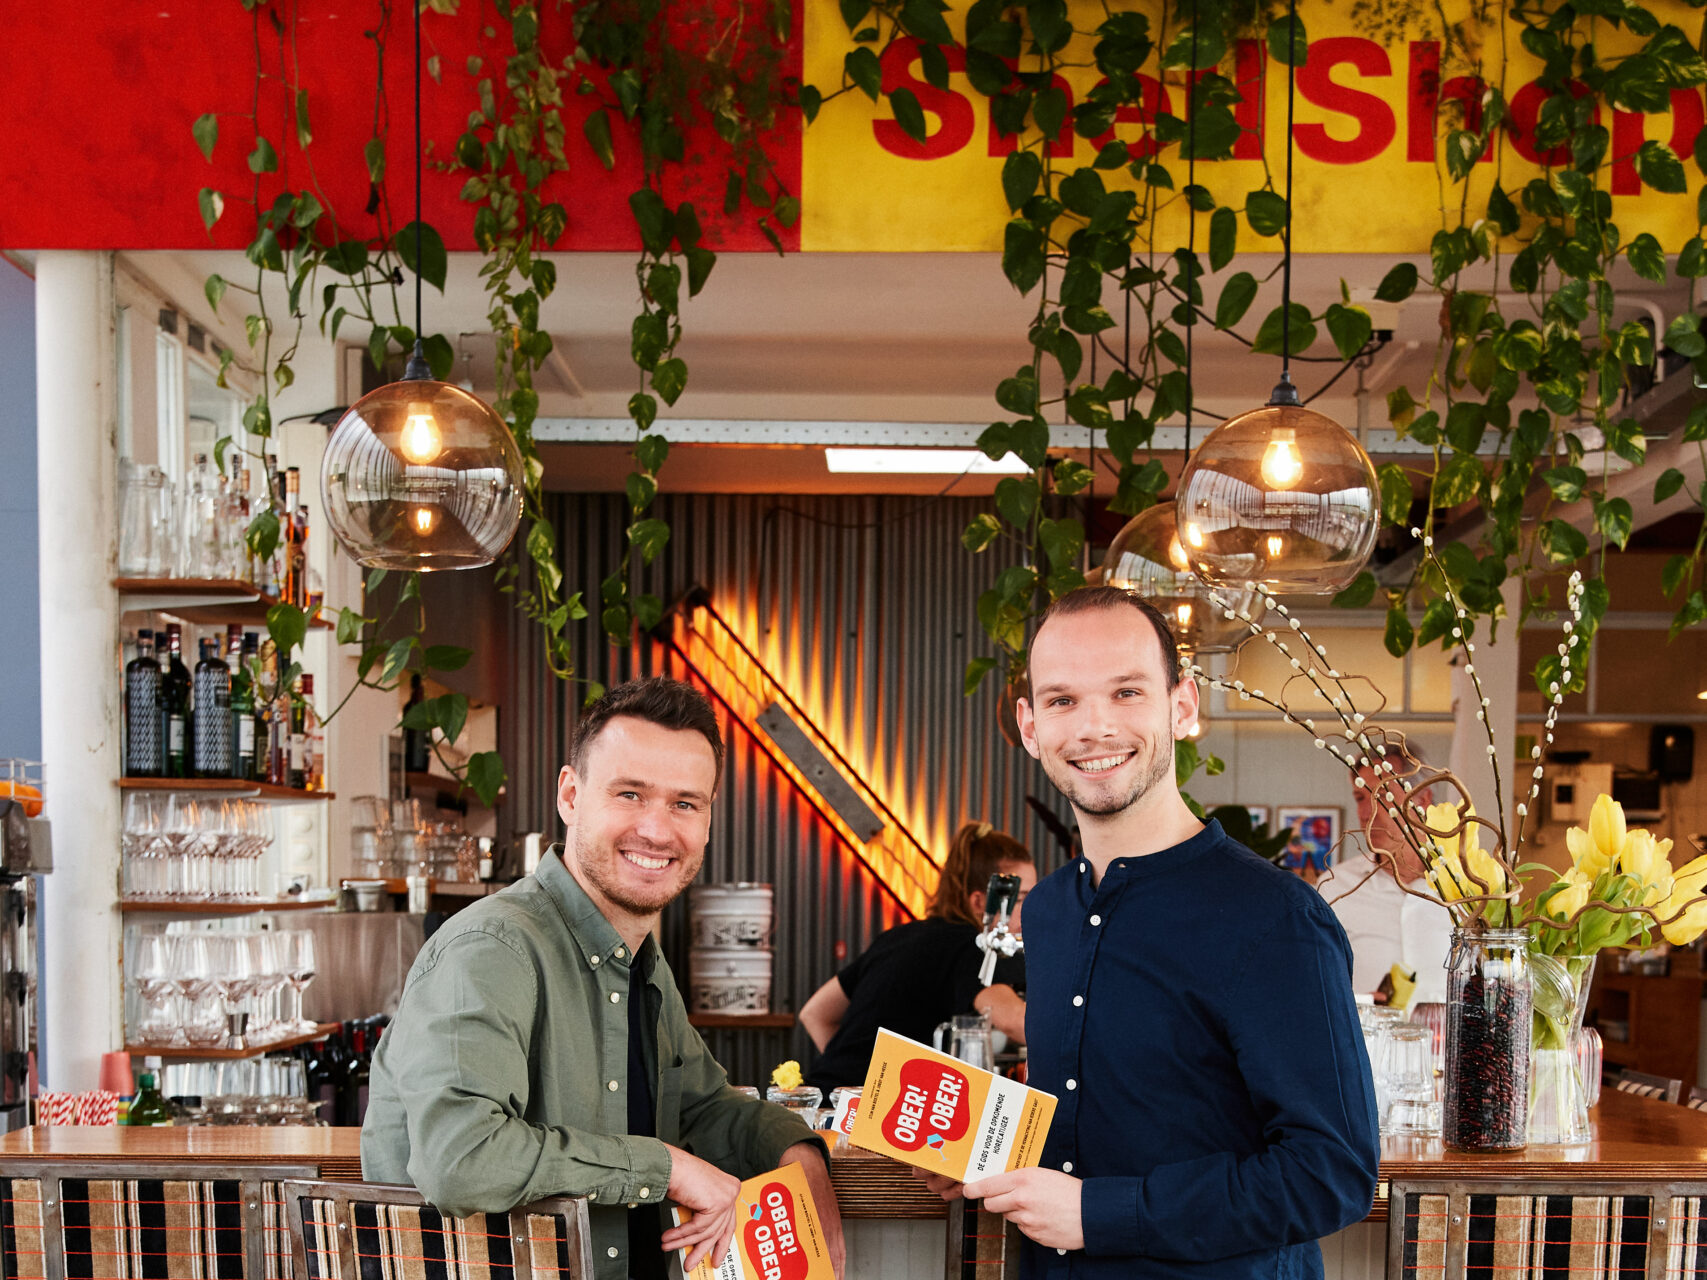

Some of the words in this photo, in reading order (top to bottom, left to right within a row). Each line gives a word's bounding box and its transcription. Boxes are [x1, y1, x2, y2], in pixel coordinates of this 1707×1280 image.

[894, 1084, 929, 1143] OBER!
[929, 1072, 963, 1131] OBER!
[990, 1093, 1005, 1127] OPKOMENDE
[984, 1134, 993, 1149] VOOR
[988, 1126, 996, 1135] DE
[980, 1150, 989, 1163] GIDS
[766, 1191, 798, 1256] OBER!
[727, 1254, 733, 1263] DE
